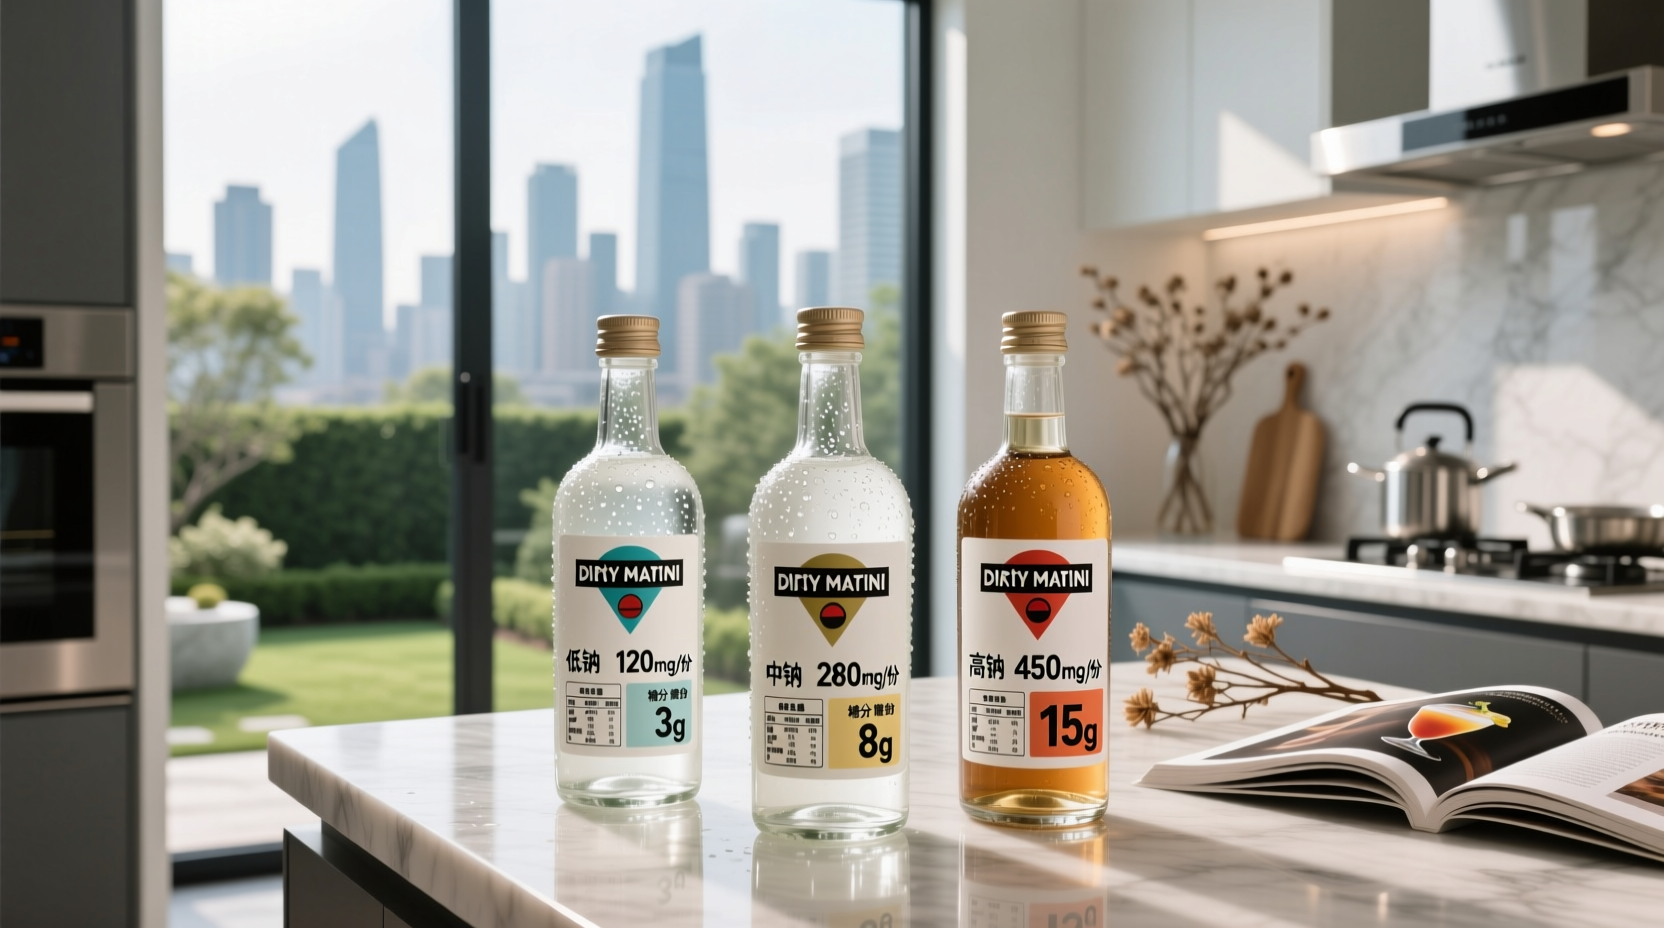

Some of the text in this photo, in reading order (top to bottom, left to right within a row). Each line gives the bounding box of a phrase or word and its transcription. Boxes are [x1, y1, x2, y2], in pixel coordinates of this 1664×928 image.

[624, 564, 680, 582] MATINI
[826, 573, 886, 592] MATINI
[1033, 569, 1090, 588] MATINI
[766, 660, 803, 688] 中钠
[969, 651, 1005, 680] 高钠
[655, 706, 686, 743] 3g
[1040, 703, 1098, 752] 15g
[858, 723, 893, 764] 8g
